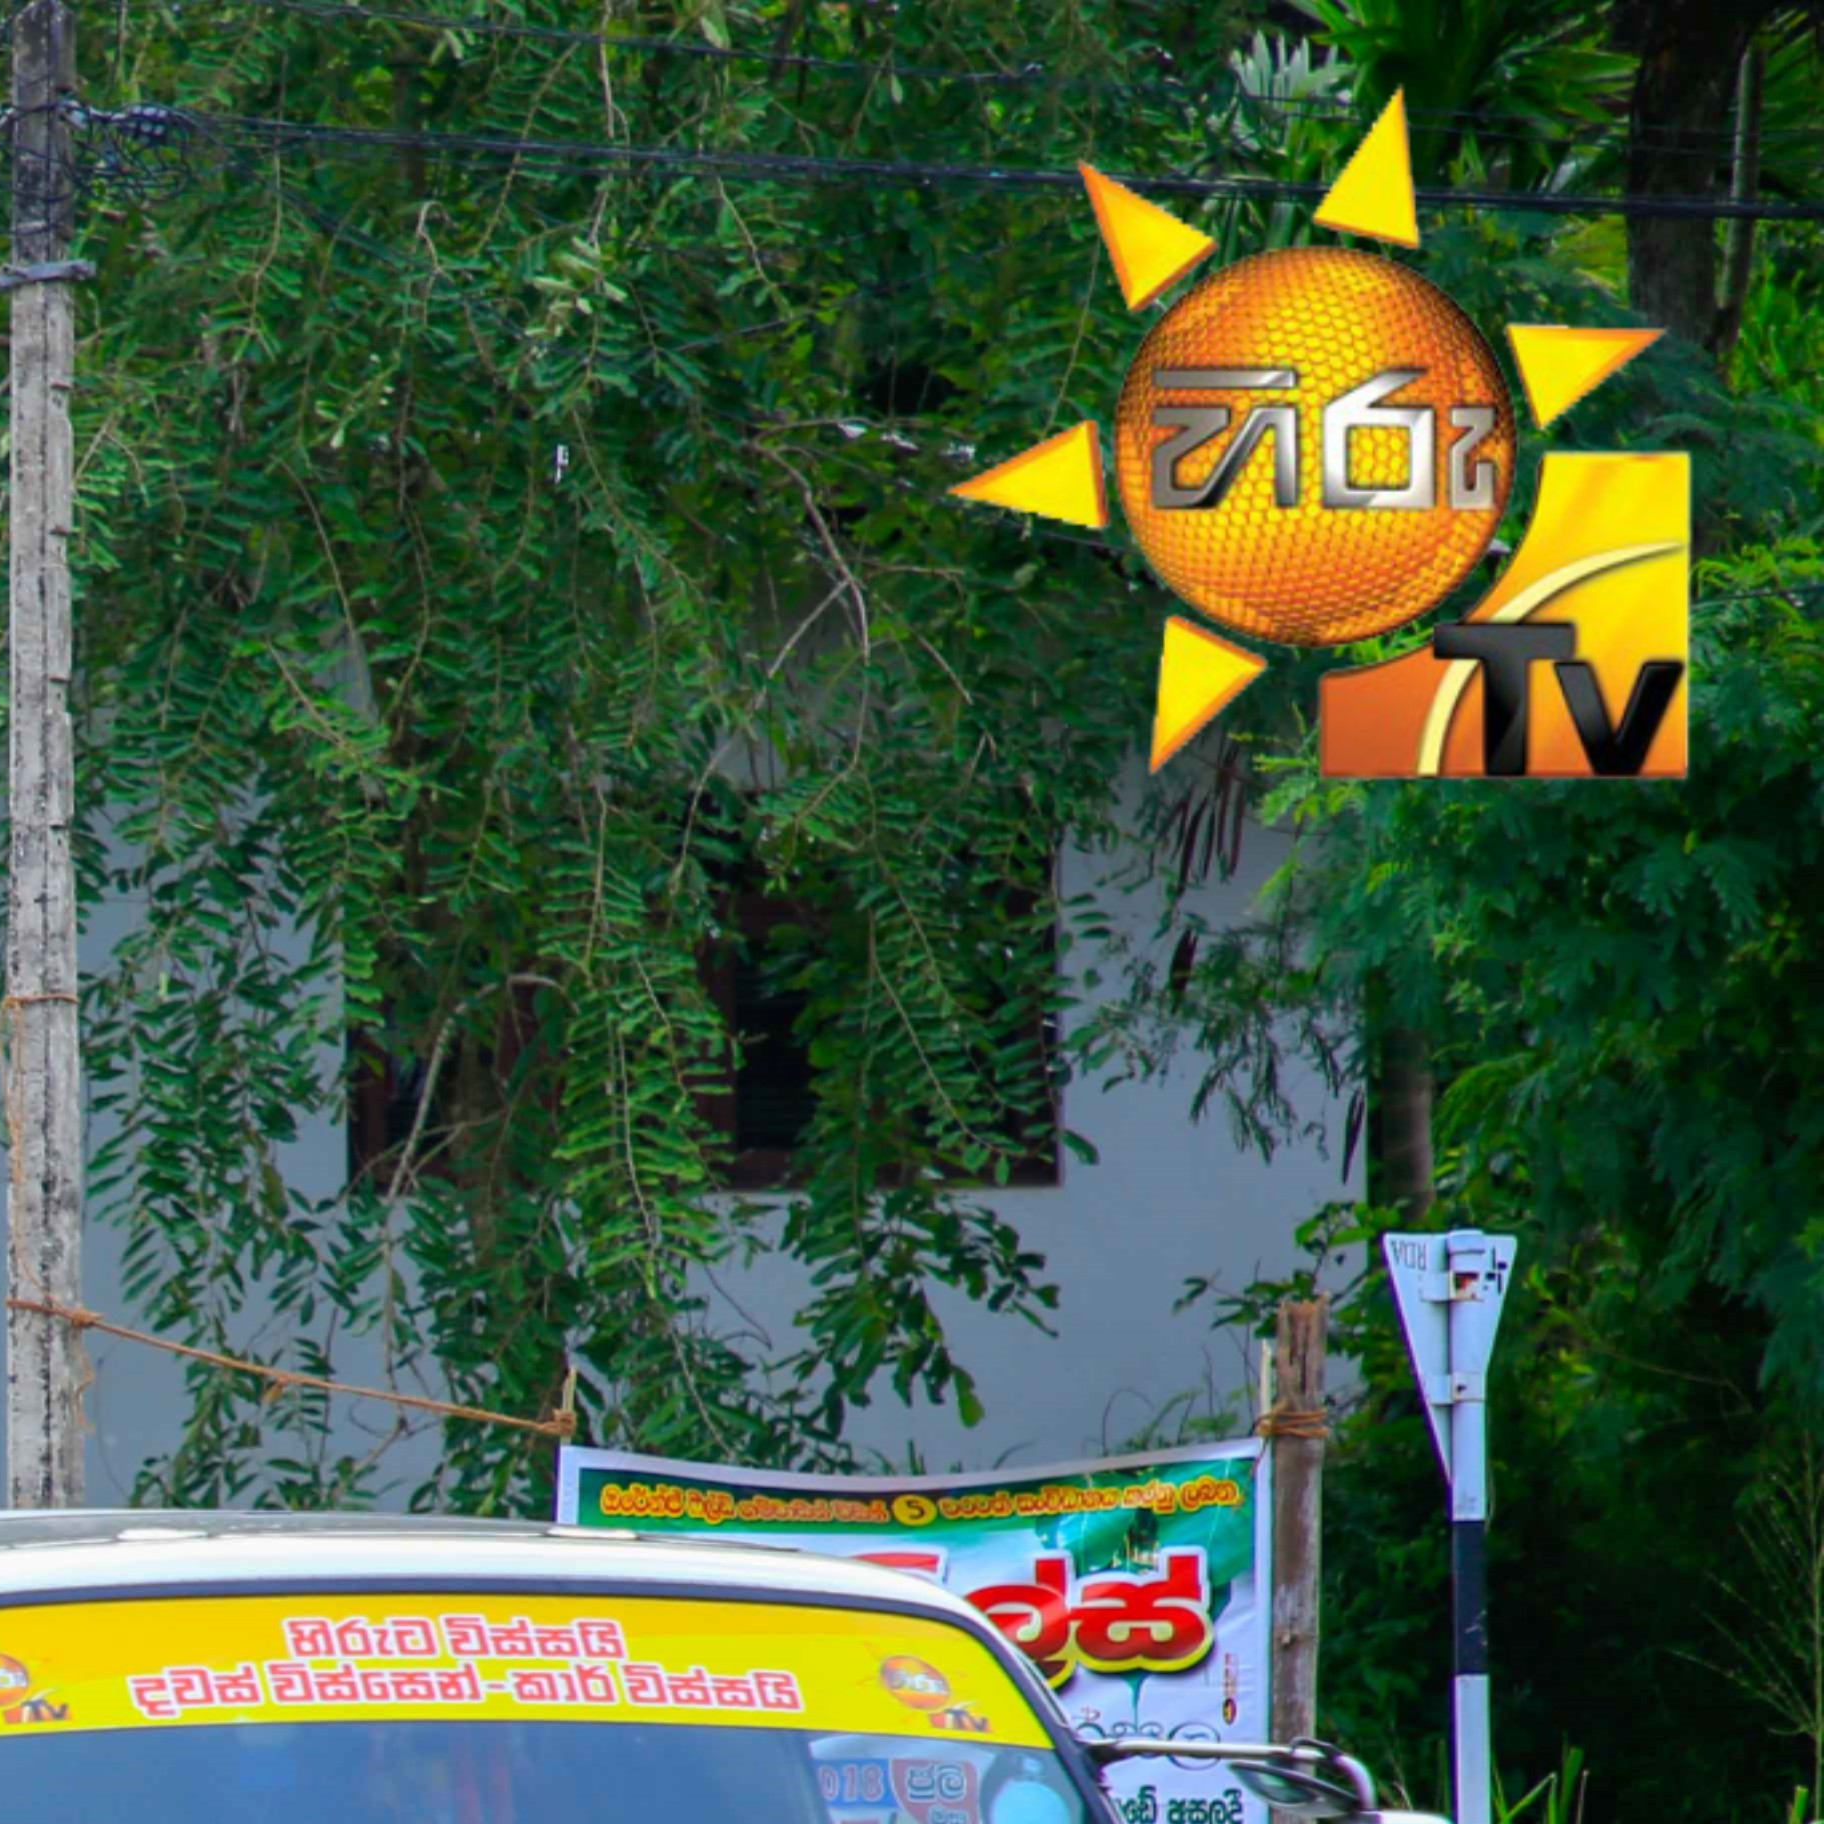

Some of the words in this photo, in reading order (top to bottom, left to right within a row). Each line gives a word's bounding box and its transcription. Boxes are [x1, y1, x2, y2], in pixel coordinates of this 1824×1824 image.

[443, 1616, 625, 1658] විස්සයි
[131, 1665, 261, 1716] දවස්
[512, 1662, 616, 1703] කාර්
[621, 1664, 802, 1711] විස්සයි
